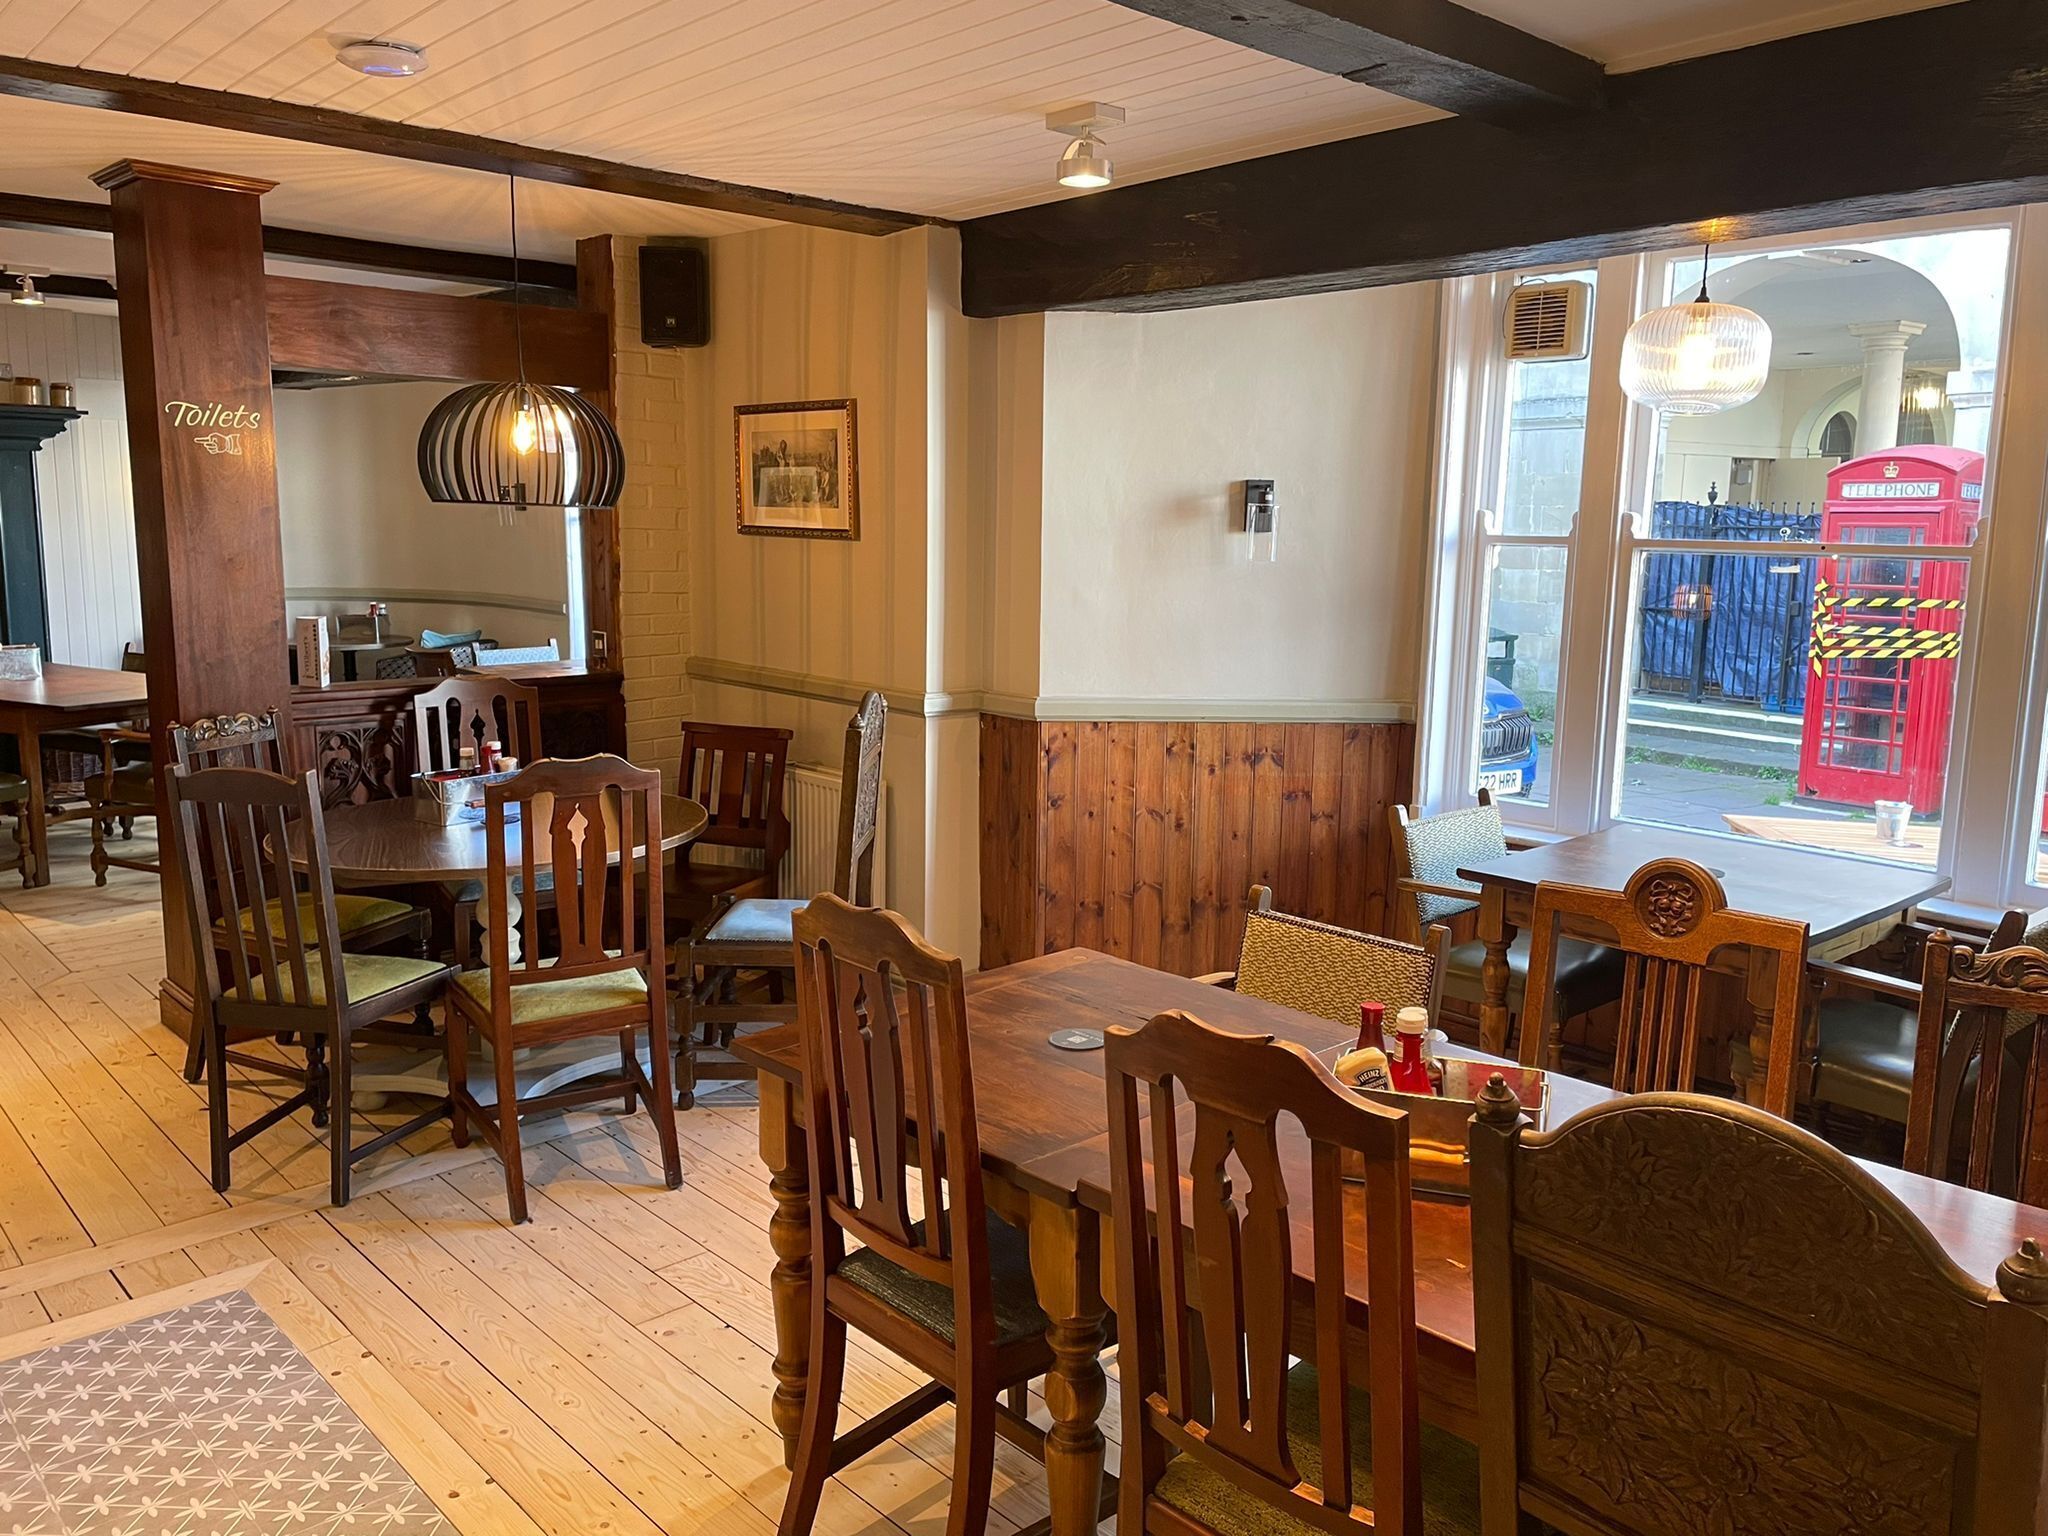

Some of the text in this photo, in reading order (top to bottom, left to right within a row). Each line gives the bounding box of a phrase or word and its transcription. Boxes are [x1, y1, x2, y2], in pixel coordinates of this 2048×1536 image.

[165, 401, 261, 429] Toilets
[1845, 483, 1936, 498] TELEPHONE
[1499, 772, 1517, 790] HRR
[1358, 1069, 1380, 1083] HEINZ
